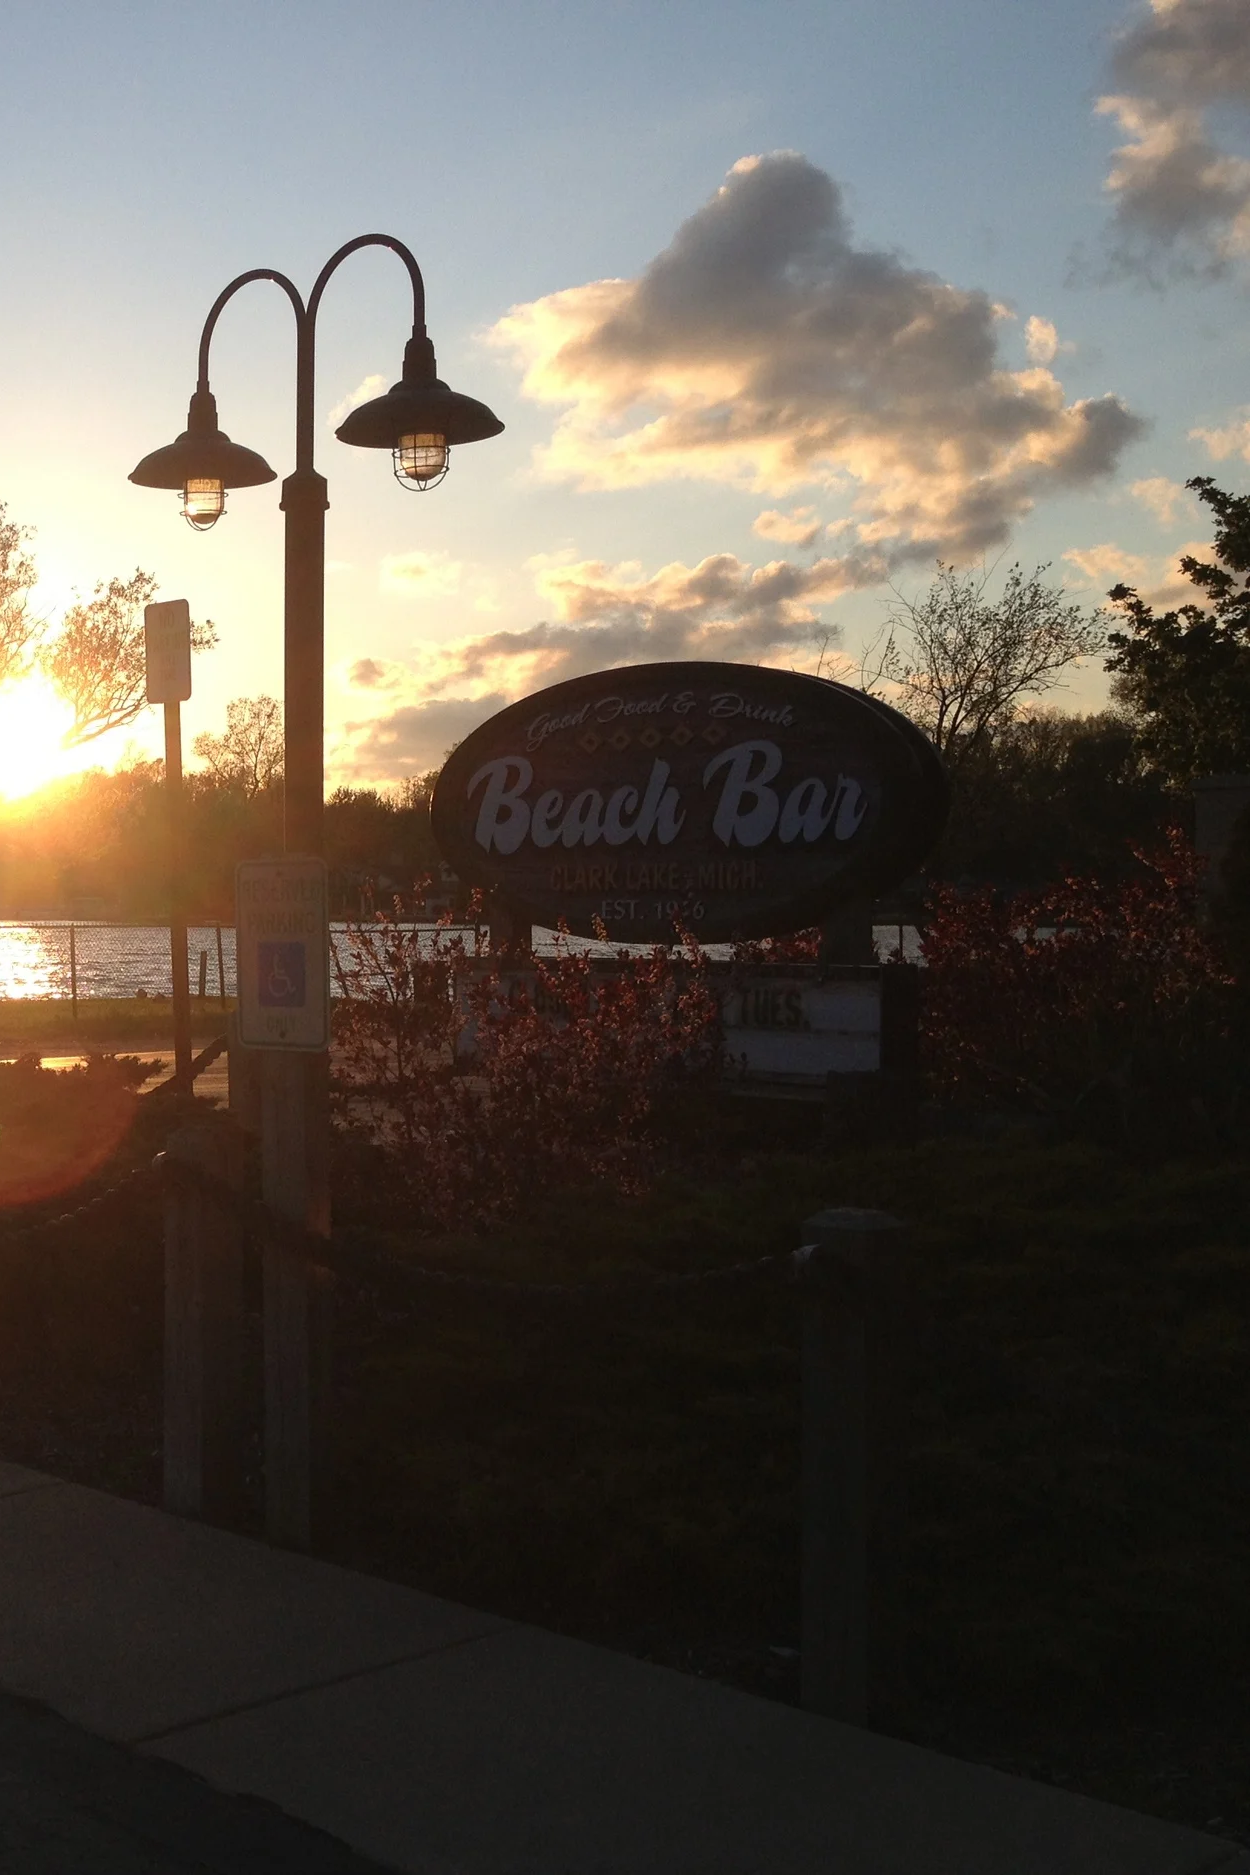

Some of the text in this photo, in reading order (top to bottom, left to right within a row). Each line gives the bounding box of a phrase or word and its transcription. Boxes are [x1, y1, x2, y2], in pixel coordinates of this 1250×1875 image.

[525, 691, 797, 752] Good Food & Drink
[467, 739, 869, 855] Beach Bar
[549, 861, 619, 891] CLARK
[698, 859, 764, 890] MICH.
[601, 899, 645, 920] EST.
[739, 987, 810, 1033] TUES.
